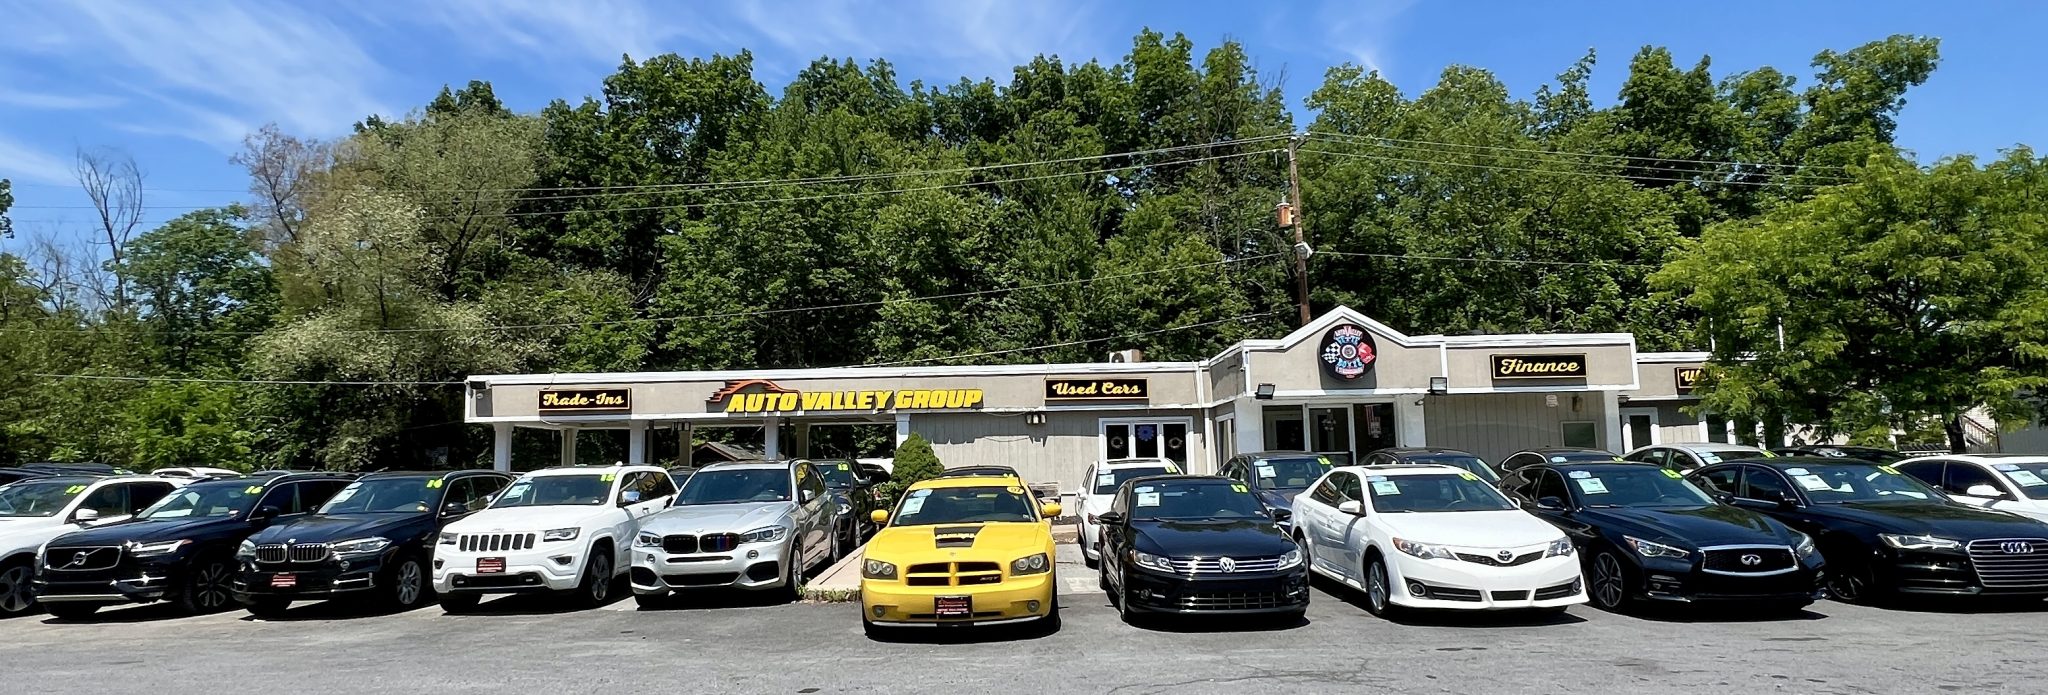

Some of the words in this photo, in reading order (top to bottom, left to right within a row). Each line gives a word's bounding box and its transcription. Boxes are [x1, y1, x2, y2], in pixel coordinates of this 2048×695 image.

[1500, 358, 1580, 375] Finance
[1051, 382, 1097, 395] Used
[1101, 382, 1141, 395] Cars
[542, 392, 625, 406] Trade-Ins
[727, 393, 799, 412] AUTO
[802, 390, 892, 411] VALLEY
[894, 389, 983, 409] GROUP
